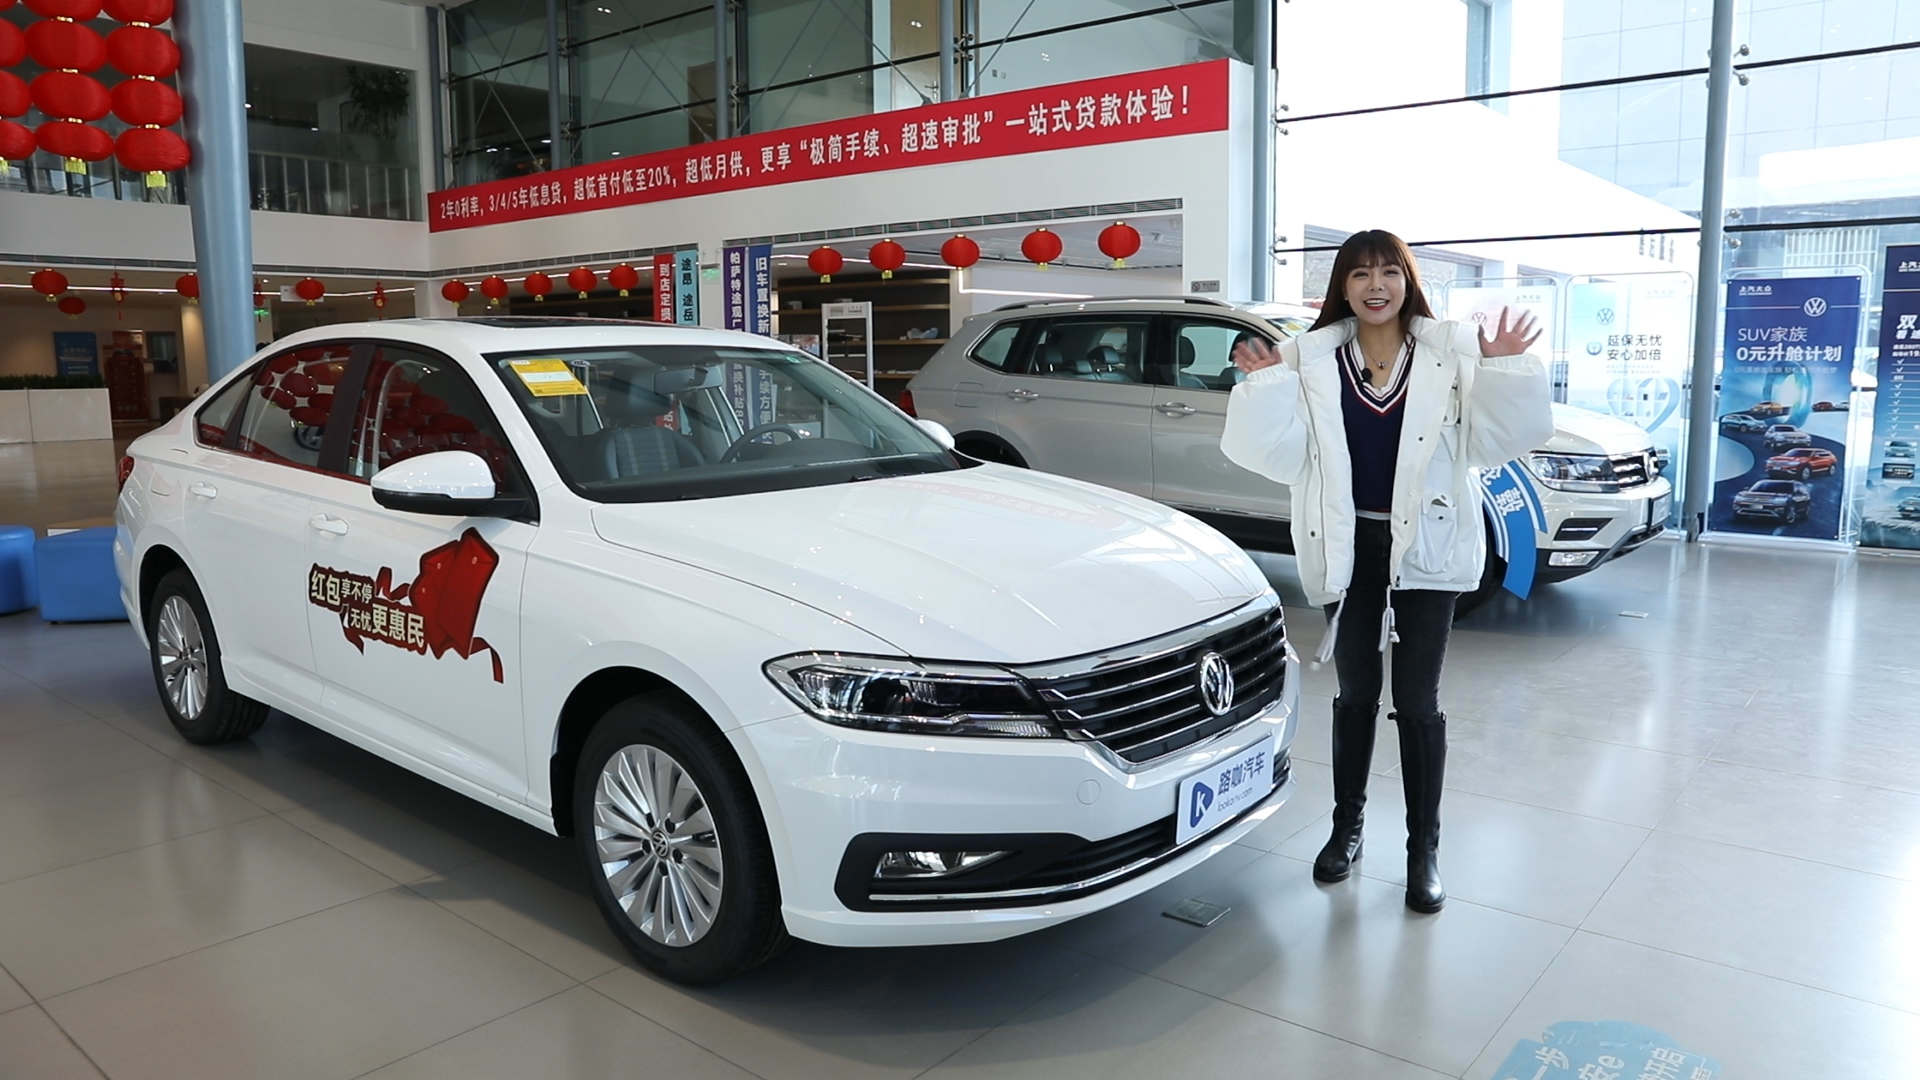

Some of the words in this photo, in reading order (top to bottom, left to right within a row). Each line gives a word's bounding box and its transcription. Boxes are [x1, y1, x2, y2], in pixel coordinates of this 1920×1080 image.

[1608, 334, 1662, 347] 延保无忧
[1738, 326, 1808, 342] SUV家族
[1607, 348, 1662, 361] 安心加倍
[1736, 342, 1842, 361] 0元升舱计划
[311, 570, 374, 606] 红包享不停
[350, 603, 426, 648] 无忧更惠民
